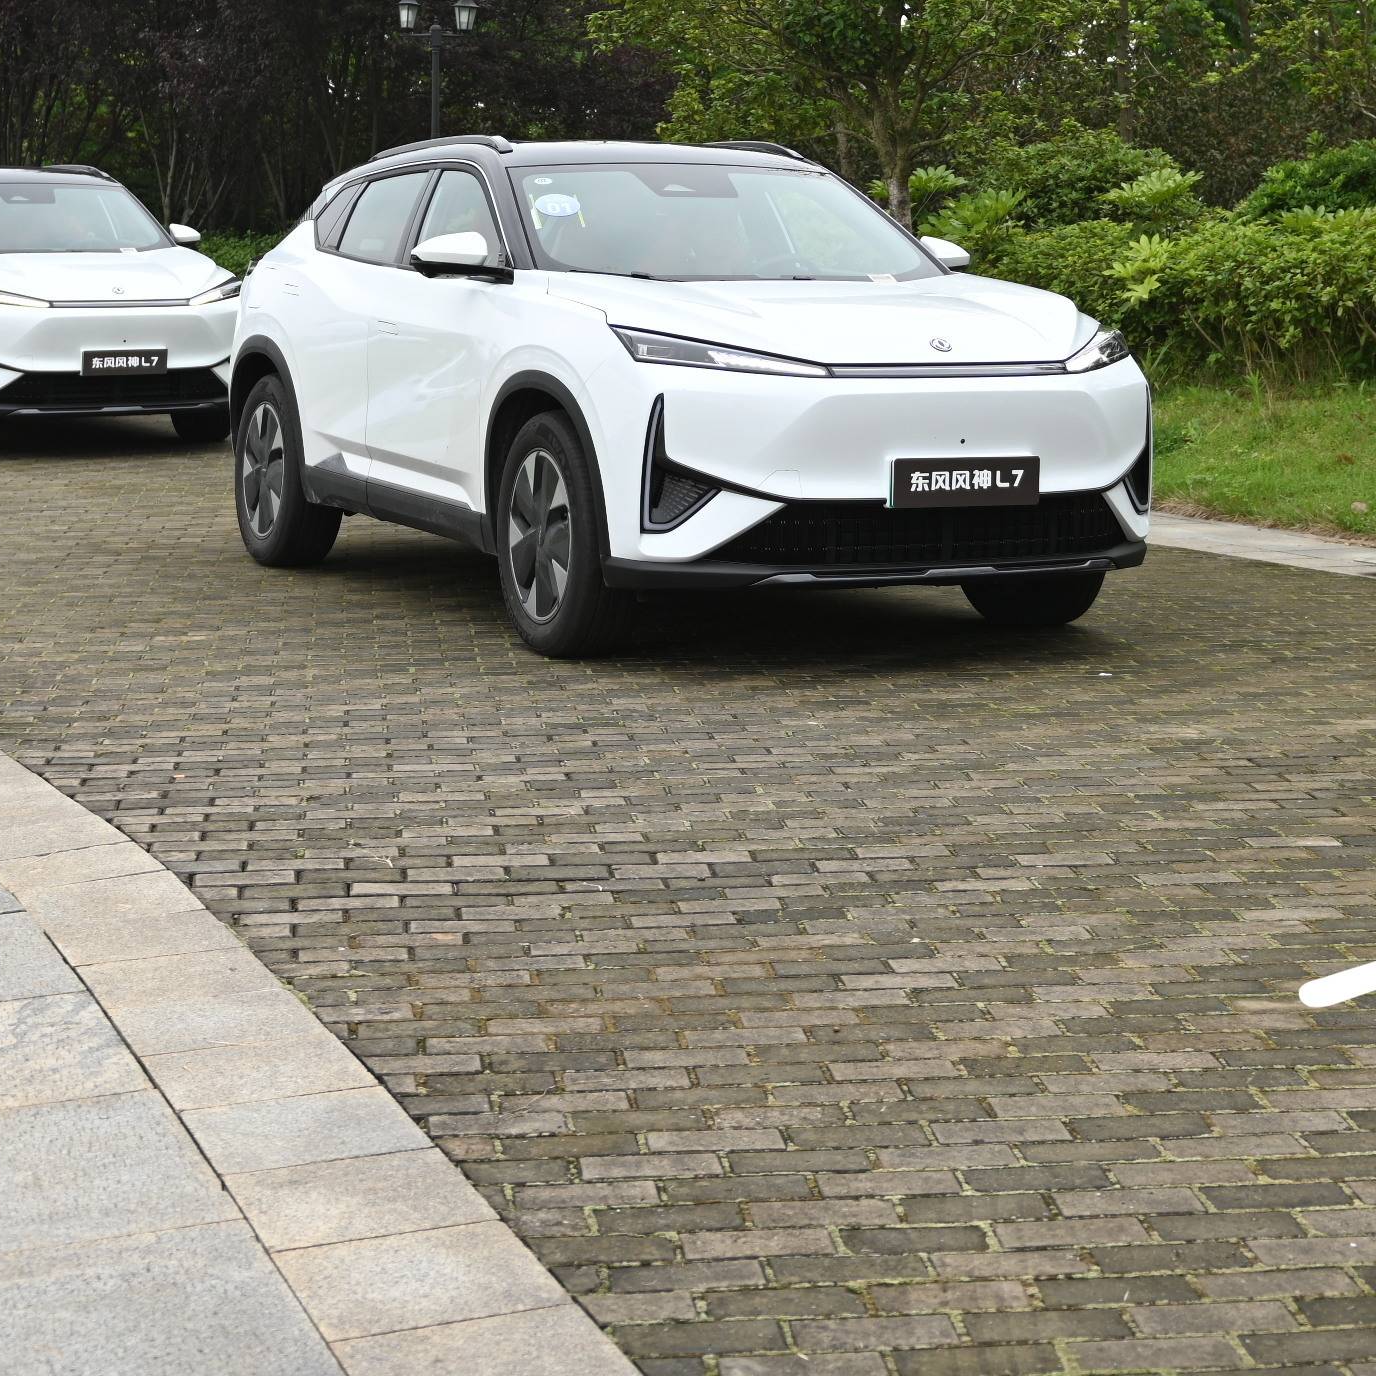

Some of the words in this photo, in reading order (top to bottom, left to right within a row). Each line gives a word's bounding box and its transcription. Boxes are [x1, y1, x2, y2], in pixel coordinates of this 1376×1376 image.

[91, 356, 159, 369] 东风风神L7
[910, 469, 1025, 492] 东风风神L7
